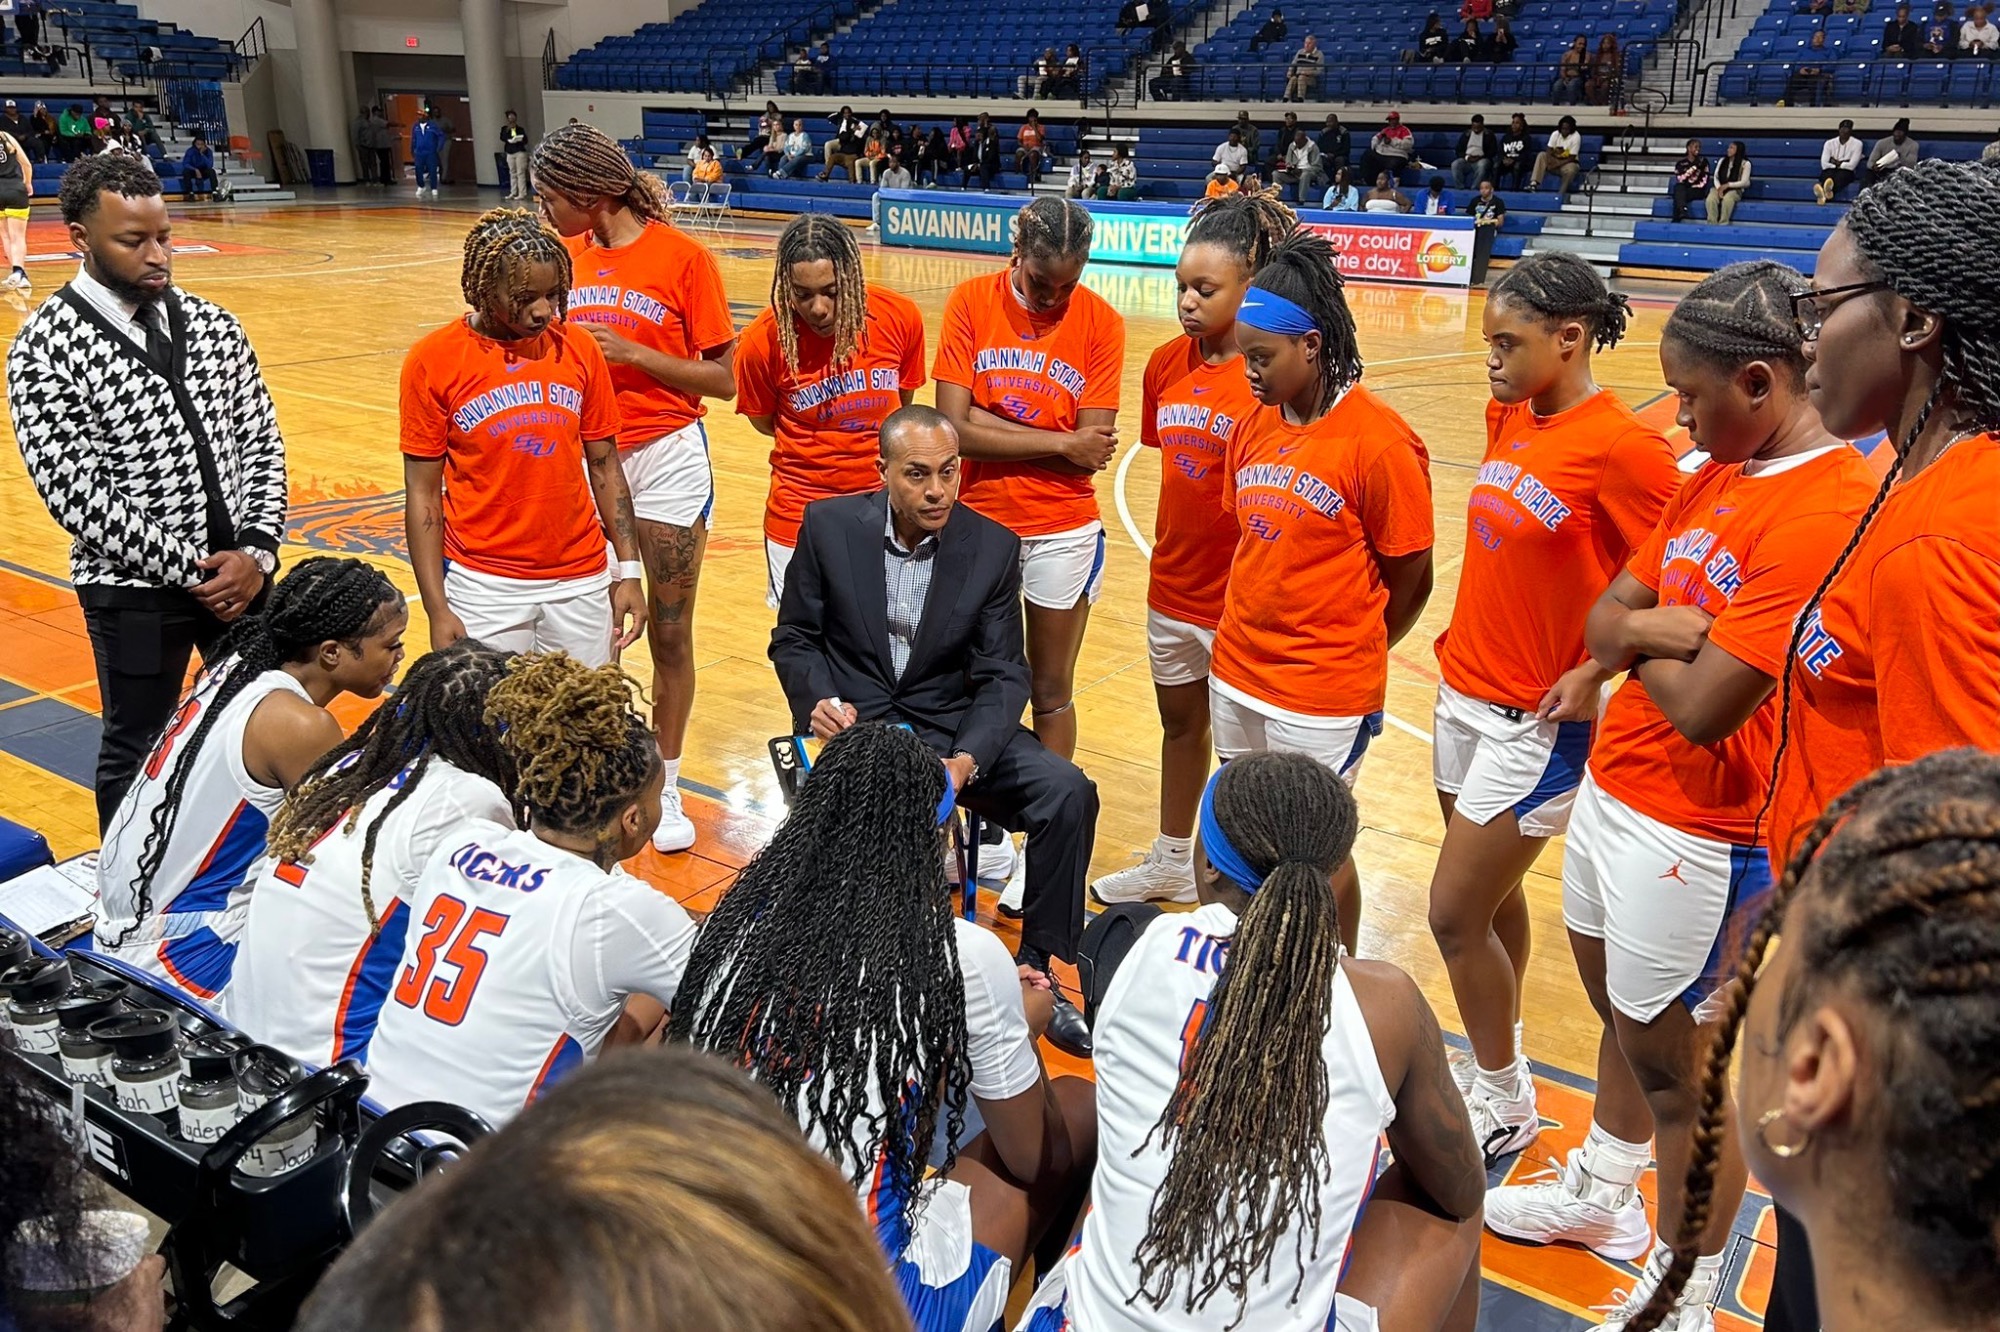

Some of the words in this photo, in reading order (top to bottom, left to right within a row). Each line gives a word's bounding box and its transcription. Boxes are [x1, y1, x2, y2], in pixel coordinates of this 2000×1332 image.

[888, 206, 1001, 242] SAVANNAH
[1090, 219, 1190, 254] UNIVERS
[1358, 234, 1411, 251] could
[1416, 253, 1465, 266] LOTTERY
[622, 289, 668, 327] STATE
[788, 367, 867, 413] SAVANNAH
[986, 375, 1060, 401] UNIVERSITY
[1048, 358, 1088, 401] STATE
[453, 380, 544, 434] SAVANNAH
[487, 411, 569, 438] UNIVERSITY
[1239, 492, 1308, 520] UNIVERSITY
[1293, 472, 1347, 520] STATE
[1512, 473, 1573, 532] STATE
[1510, 708, 1518, 718] S
[394, 892, 511, 1027] 35
